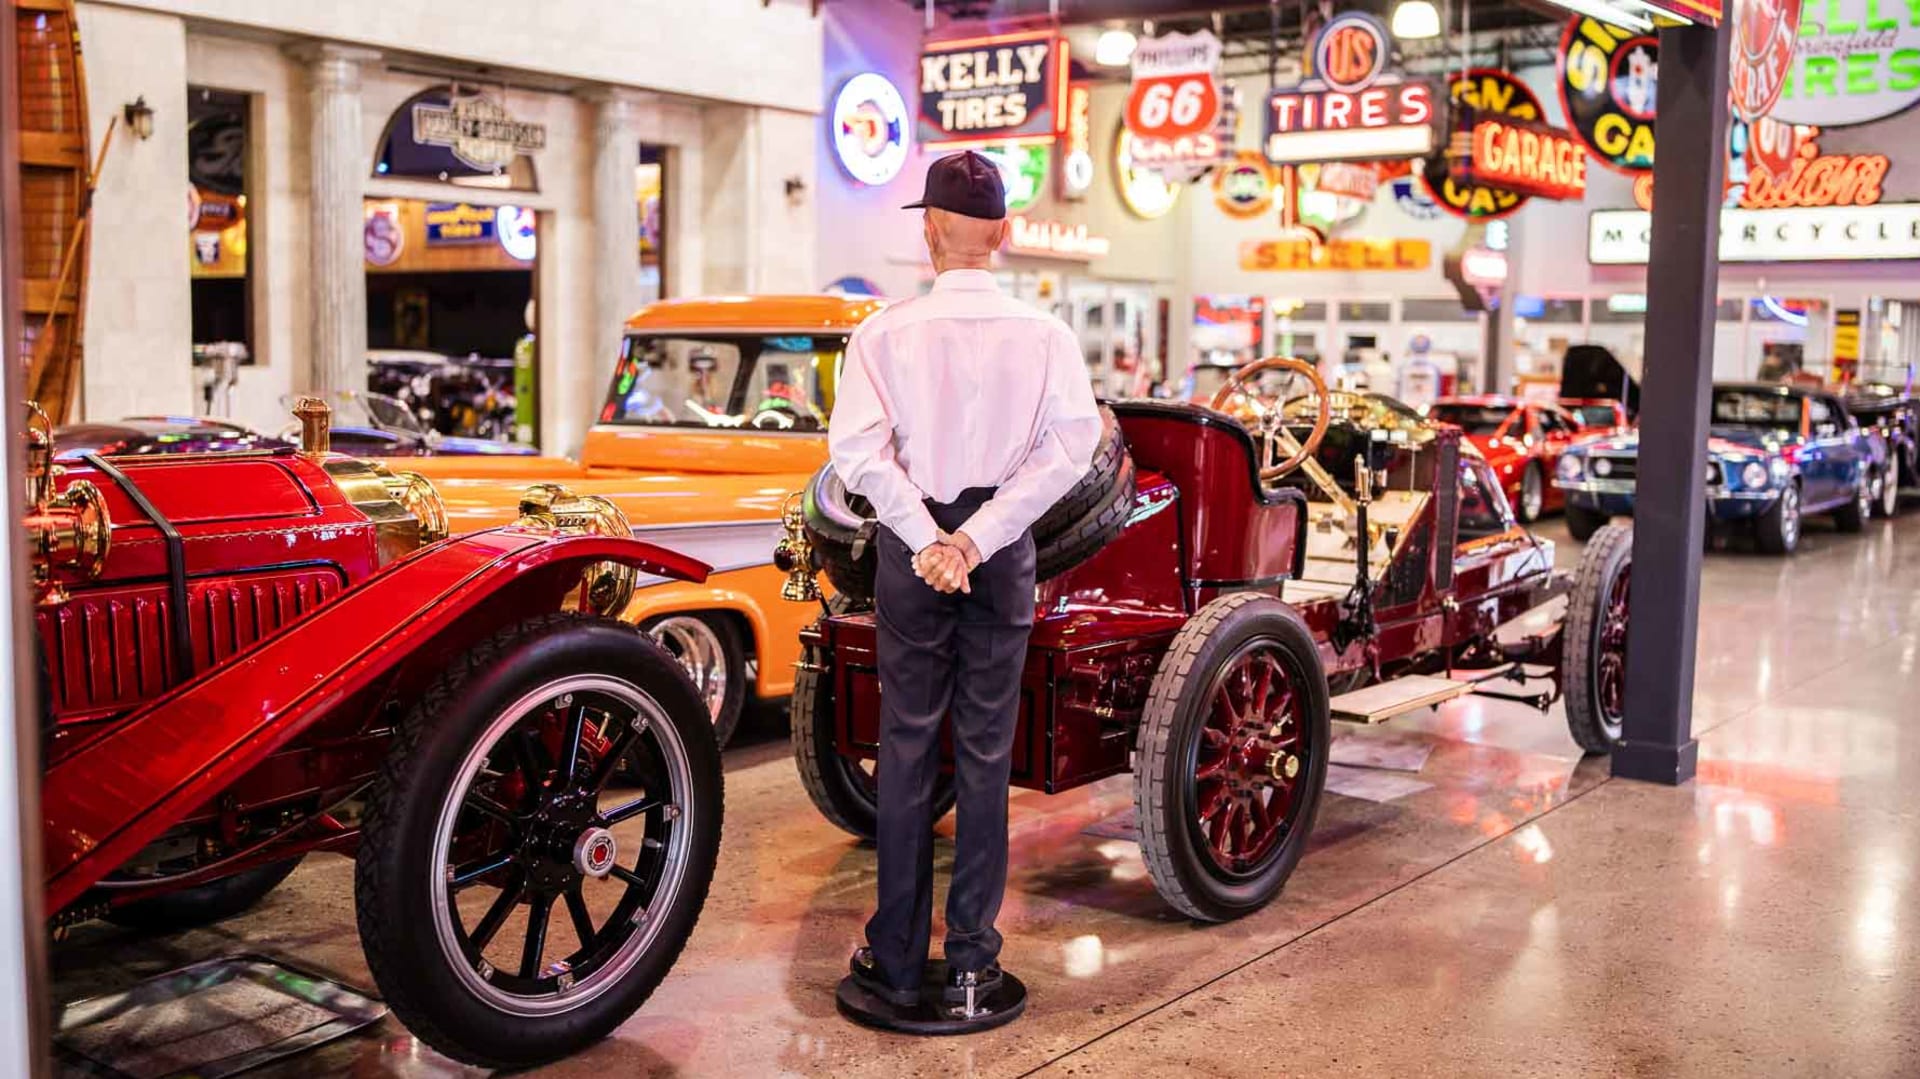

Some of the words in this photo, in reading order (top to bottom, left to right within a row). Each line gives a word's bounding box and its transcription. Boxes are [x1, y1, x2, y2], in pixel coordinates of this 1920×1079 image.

[921, 44, 1049, 93] KELLY
[1327, 27, 1375, 83] US
[1782, 49, 1920, 98] IRES
[937, 92, 1027, 131] TIRES
[1138, 80, 1206, 129] 66
[1271, 86, 1428, 131] TIRES
[1484, 122, 1586, 188] GARAGE
[1256, 243, 1415, 268] SHELL
